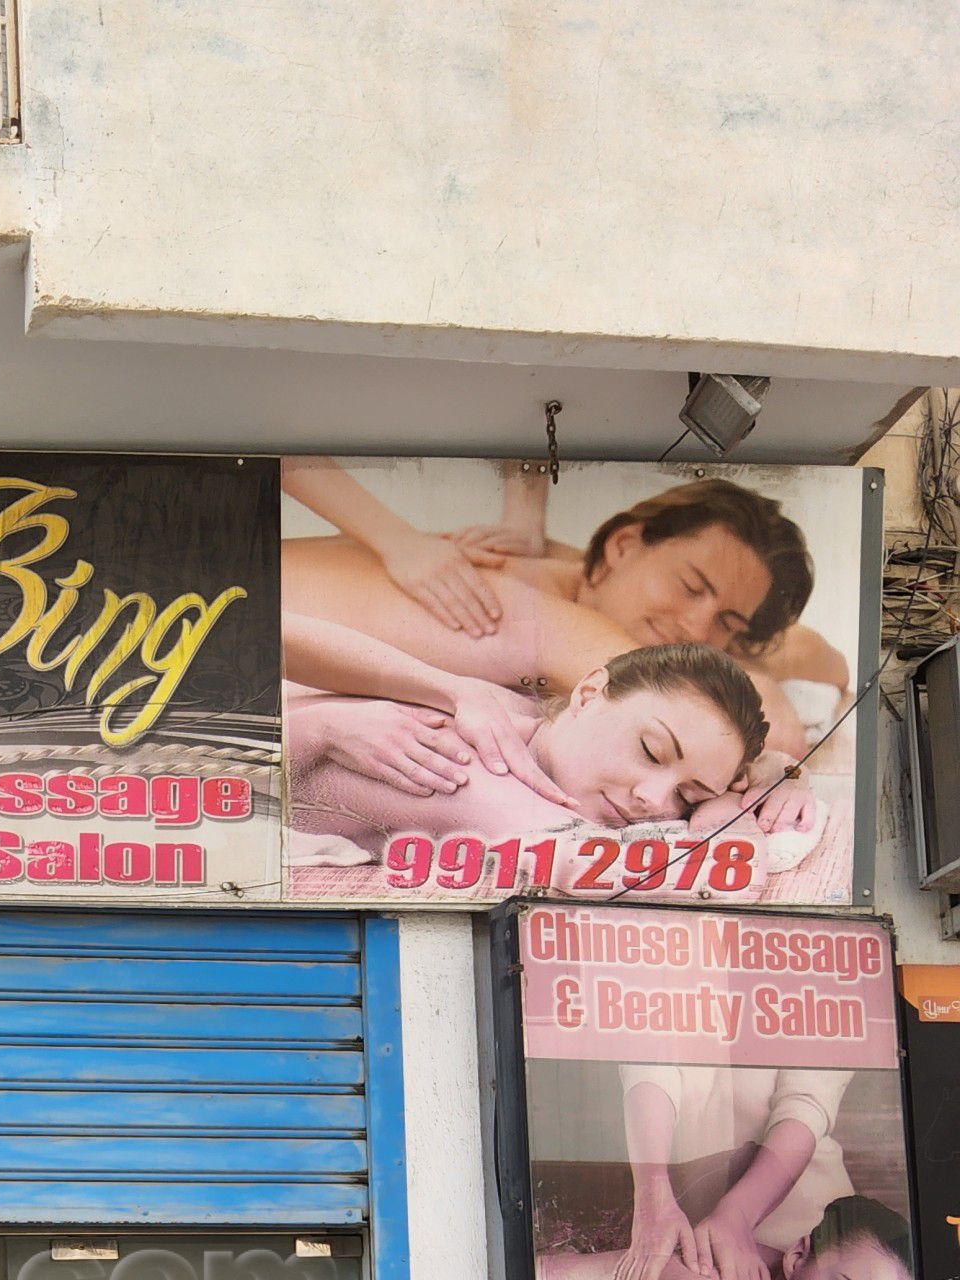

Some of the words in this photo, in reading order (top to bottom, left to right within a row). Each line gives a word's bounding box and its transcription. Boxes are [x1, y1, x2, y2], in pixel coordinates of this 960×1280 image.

[386, 836, 557, 889] 9911
[573, 837, 755, 892] 2978
[530, 910, 691, 966] Chinese
[701, 918, 882, 981] Massage
[555, 978, 585, 1028] &
[596, 980, 743, 1042] Beauty
[755, 987, 864, 1038] Salon
